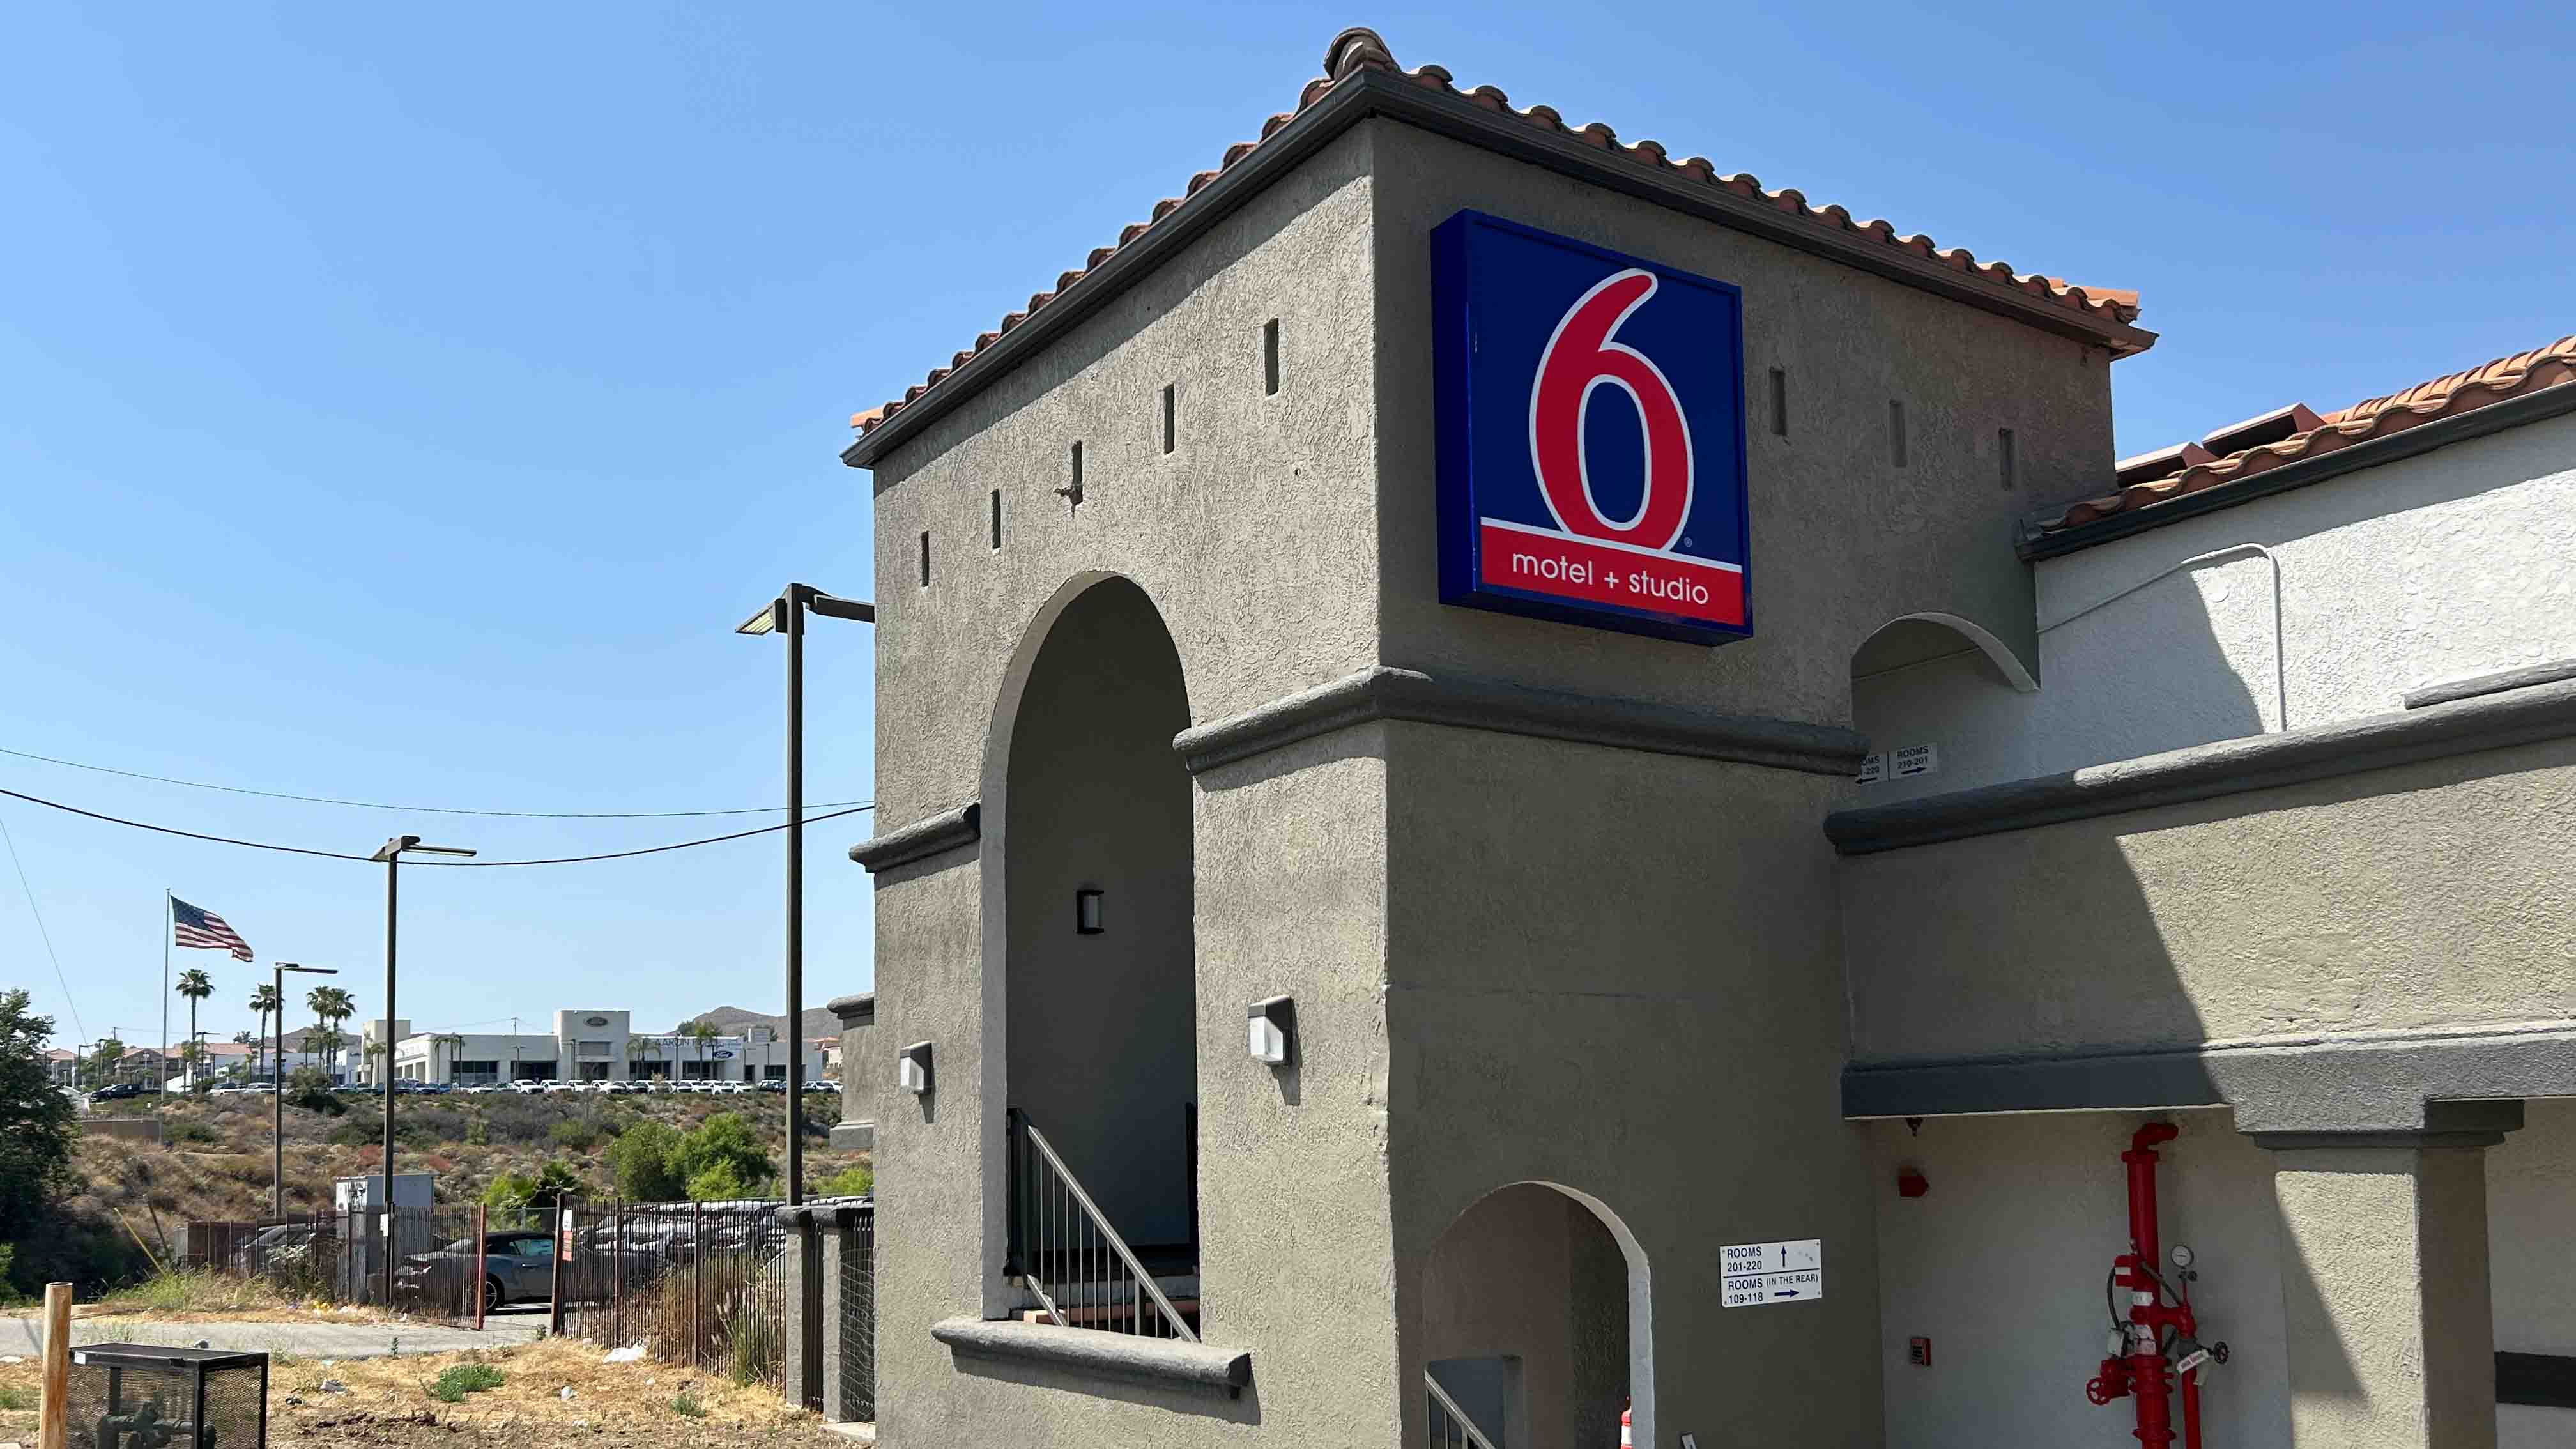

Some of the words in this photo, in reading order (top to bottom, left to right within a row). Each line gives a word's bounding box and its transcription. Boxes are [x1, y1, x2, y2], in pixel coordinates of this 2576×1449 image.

[1529, 268, 1694, 553] 6
[1512, 553, 1593, 585] motel
[1604, 572, 1619, 588] +
[1629, 570, 1709, 604] studio
[1897, 746, 1929, 759] ROOMS
[1860, 756, 1880, 766] OMS
[1727, 1246, 1762, 1259] ROOMS
[1727, 1261, 1762, 1272] 201-220
[1728, 1278, 1763, 1291] ROOMS
[1766, 1277, 1777, 1288] (IN
[1779, 1276, 1793, 1285] THE
[1796, 1273, 1819, 1284] REAR)
[1729, 1292, 1763, 1304] 109-118
